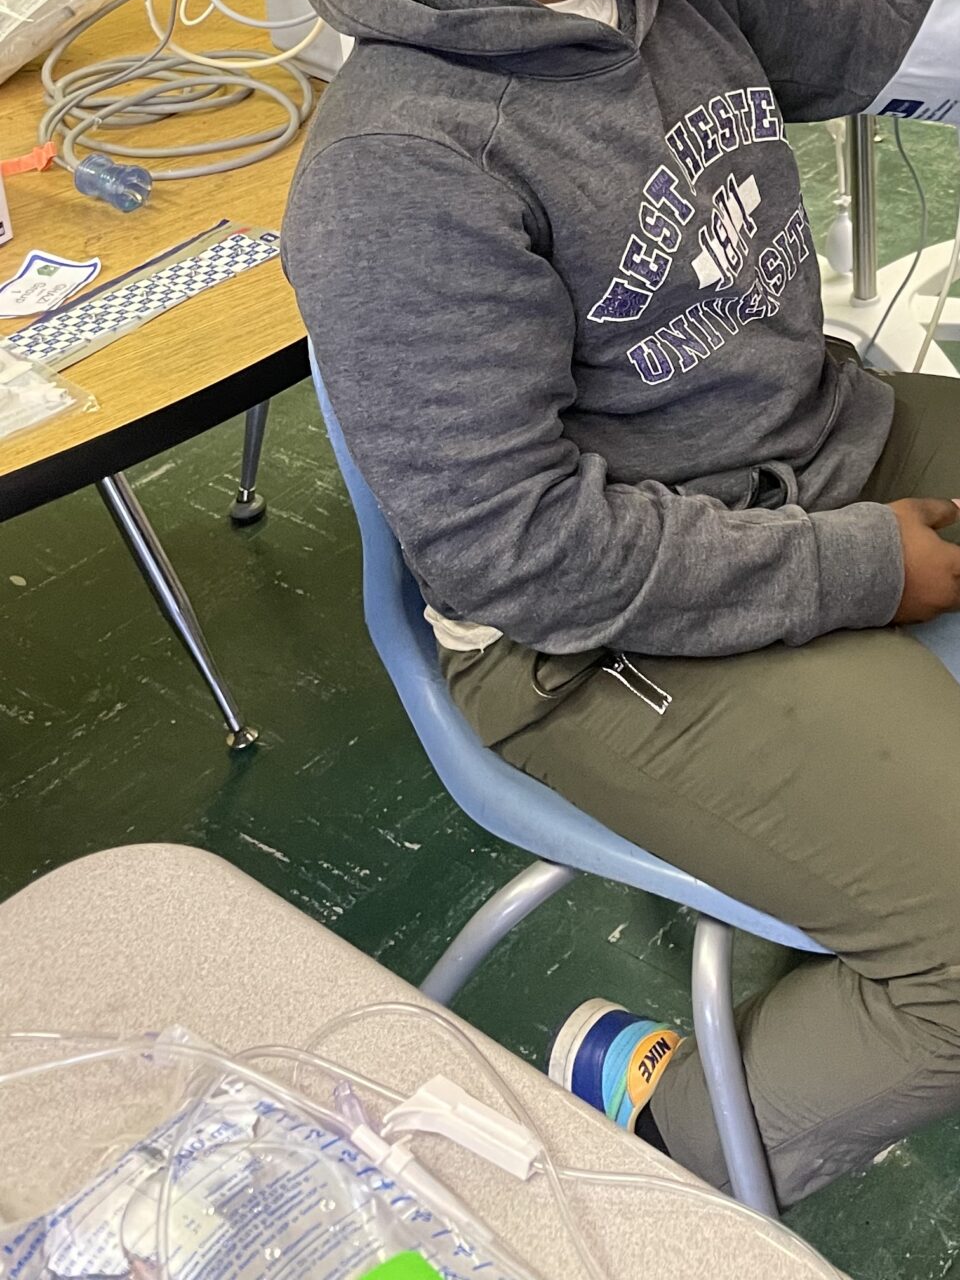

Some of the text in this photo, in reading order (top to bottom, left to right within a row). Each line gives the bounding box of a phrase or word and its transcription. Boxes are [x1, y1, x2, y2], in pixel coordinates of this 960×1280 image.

[665, 86, 788, 195] HESTE
[627, 209, 812, 385] UNIVESIT
[638, 1037, 672, 1084] NIKE
